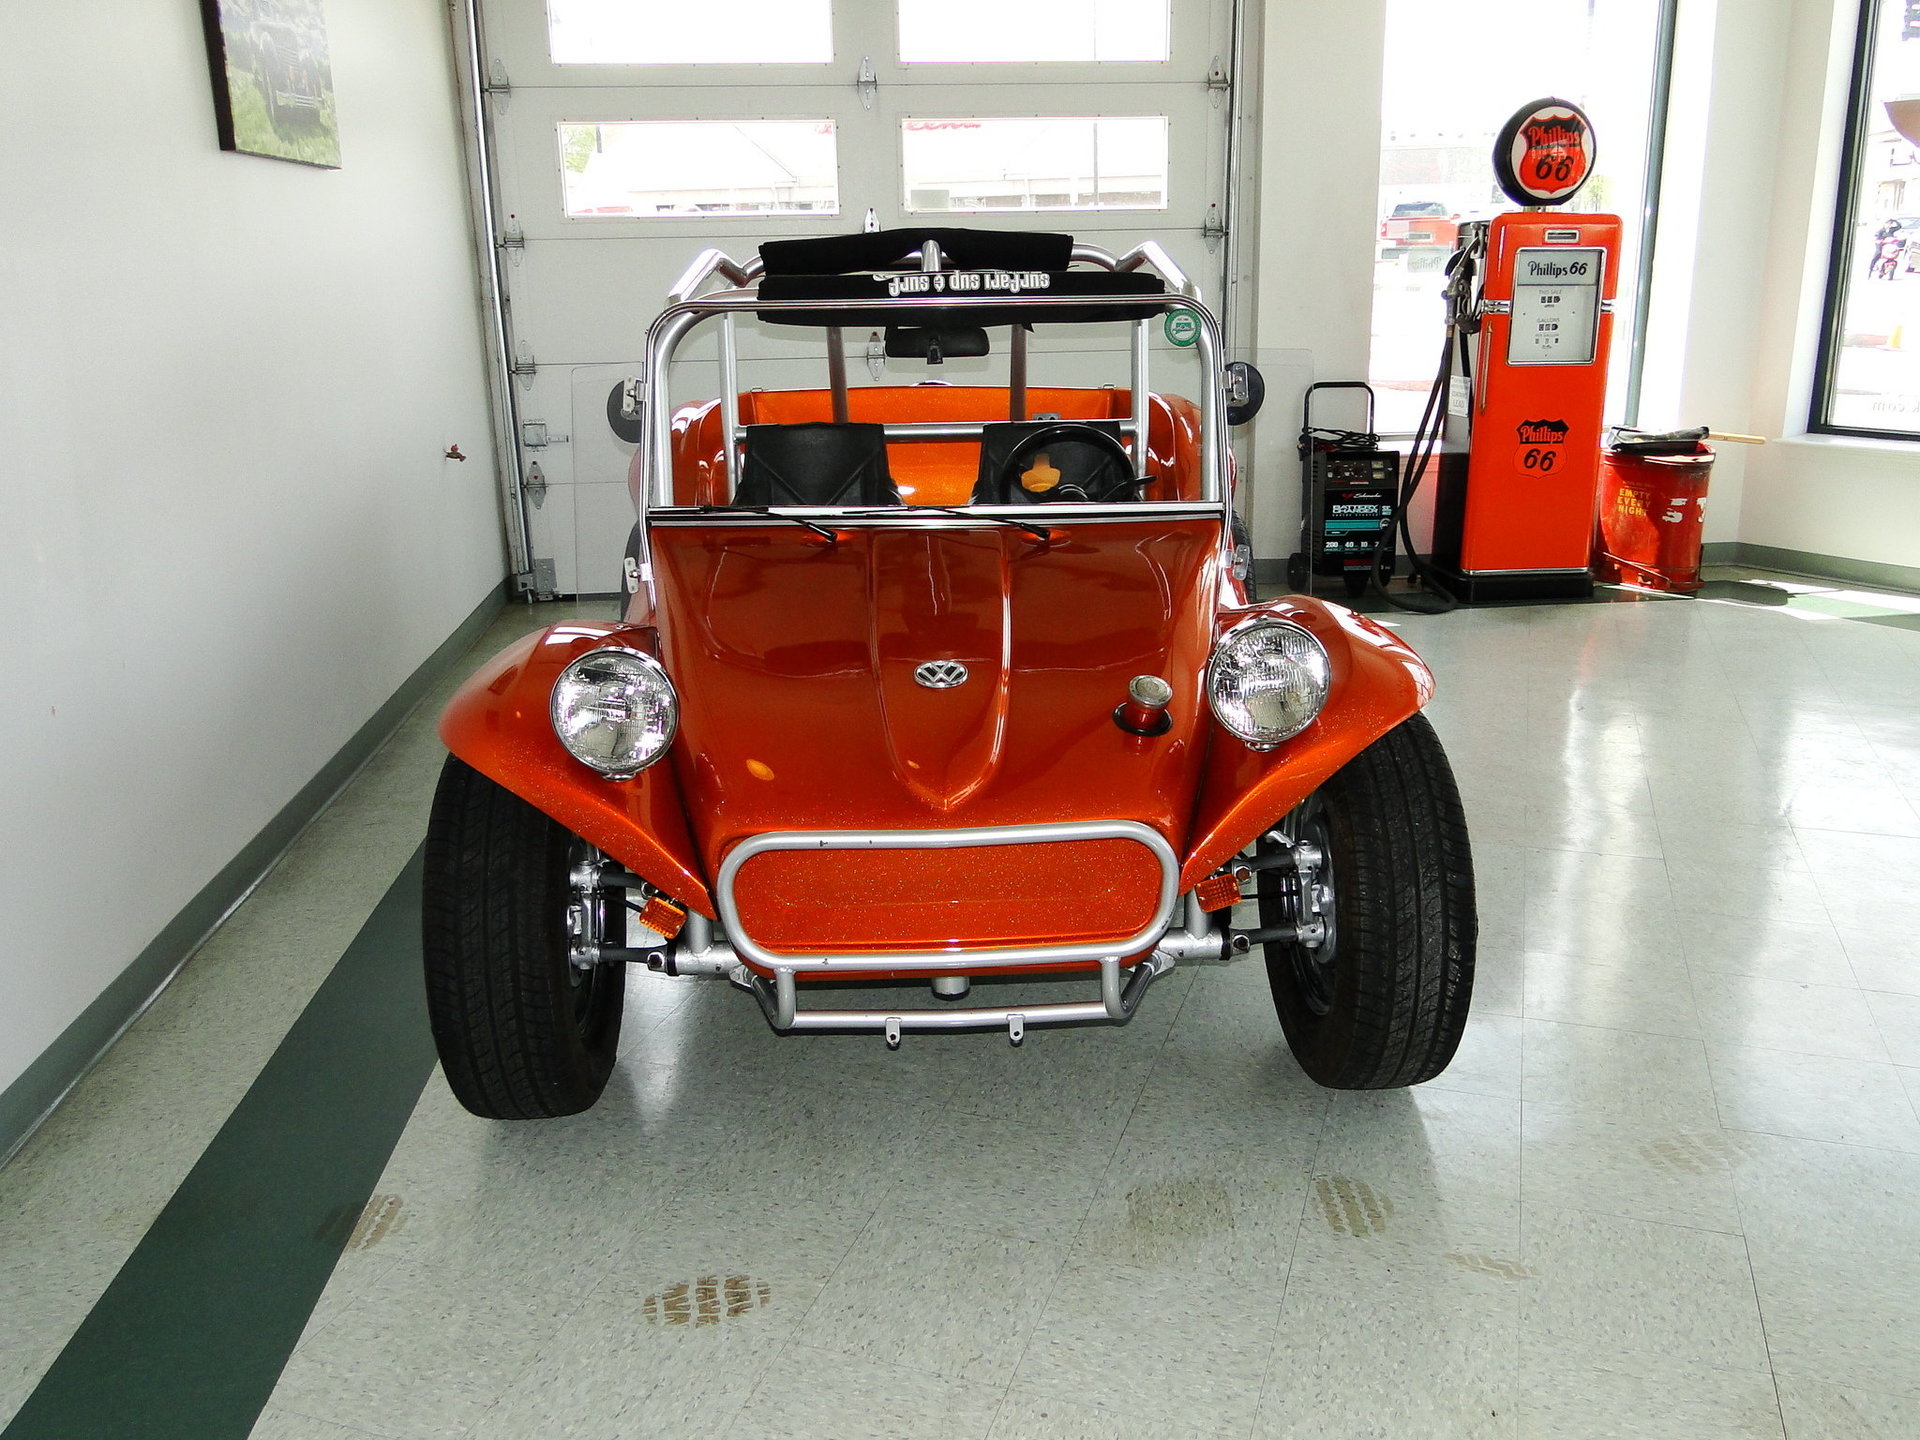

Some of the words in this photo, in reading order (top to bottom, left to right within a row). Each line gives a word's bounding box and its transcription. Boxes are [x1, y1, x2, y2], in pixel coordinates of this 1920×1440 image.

[1528, 125, 1580, 146] Phillips
[1535, 154, 1574, 182] 66
[1528, 260, 1568, 278] Phillips
[1569, 262, 1588, 275] 66
[889, 274, 930, 297] surf
[949, 270, 980, 291] sup
[1520, 425, 1563, 442] Phillips
[1523, 448, 1557, 472] 66
[1617, 496, 1651, 508] EVERY
[1619, 488, 1651, 499] EMPTY
[1617, 505, 1648, 516] NIGHT
